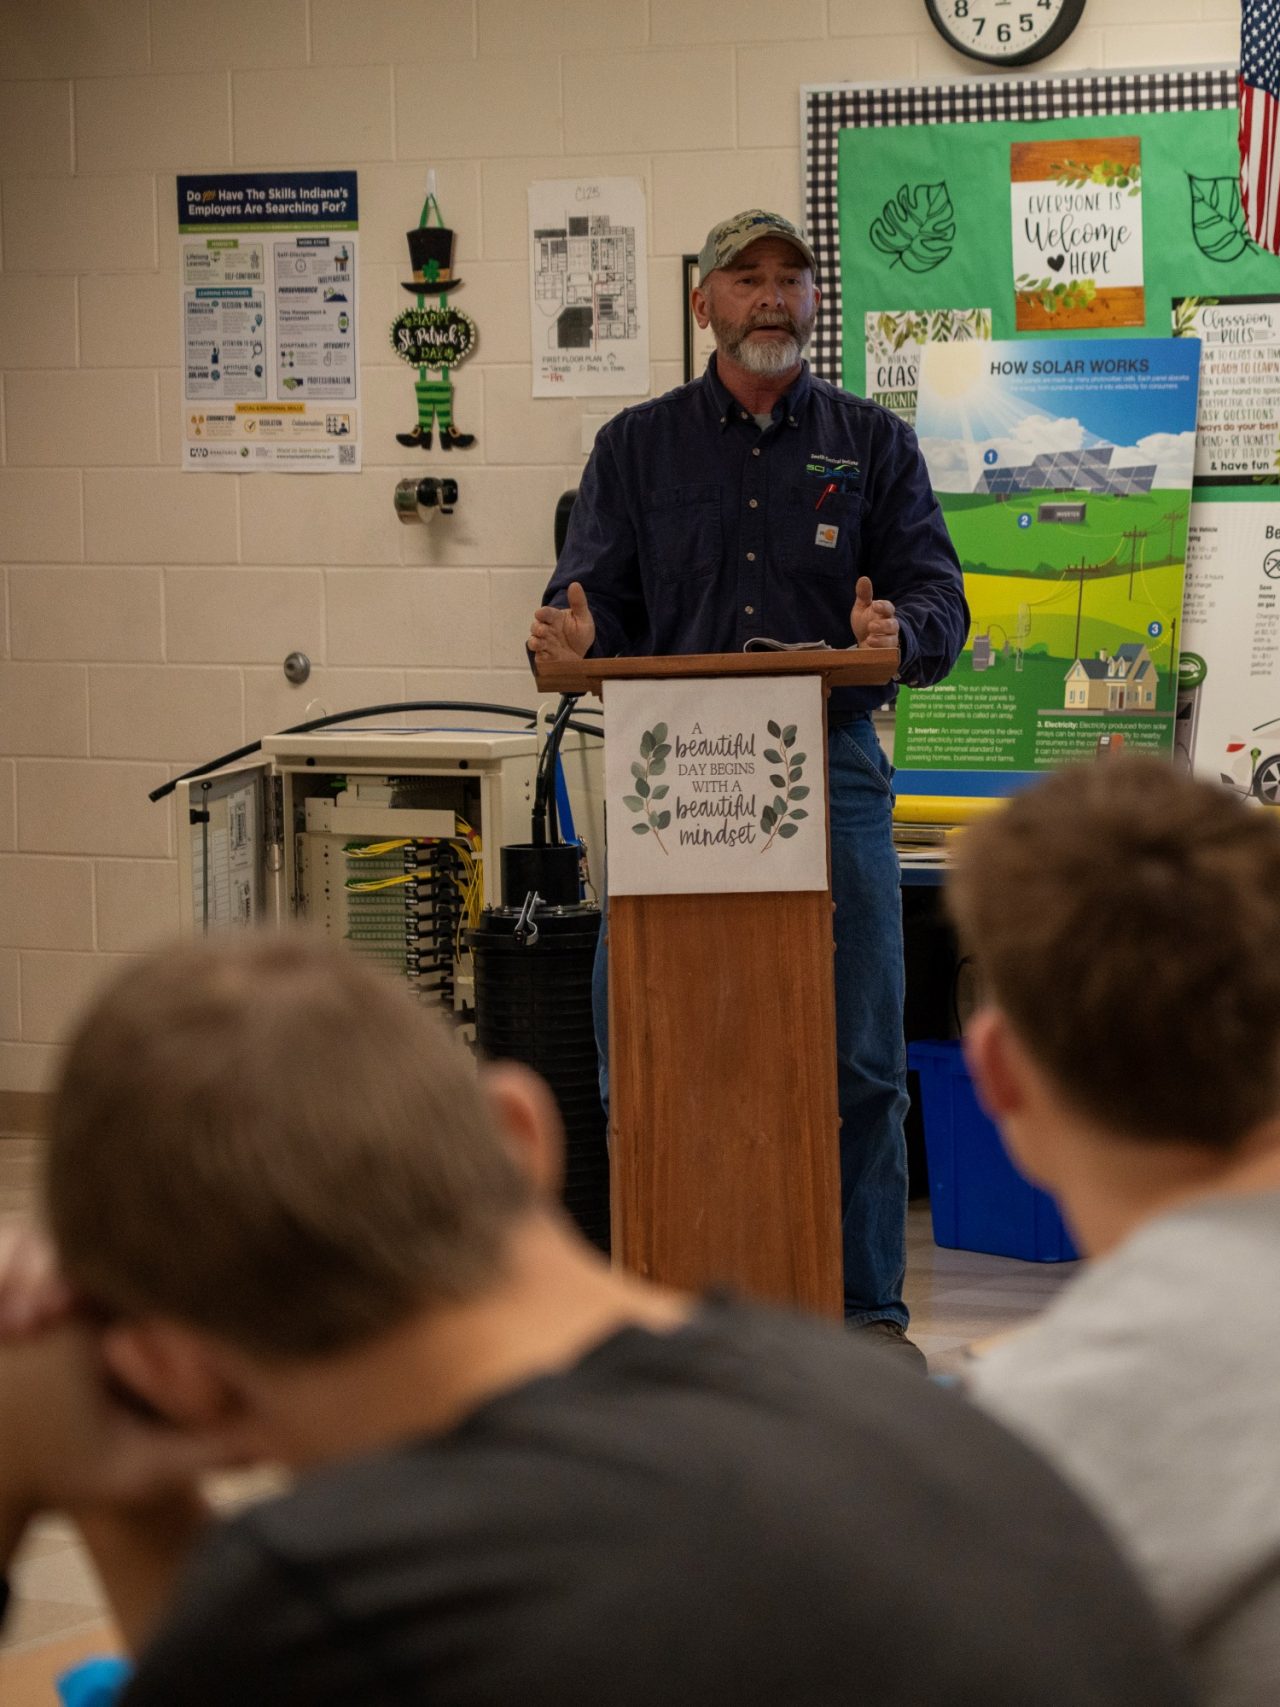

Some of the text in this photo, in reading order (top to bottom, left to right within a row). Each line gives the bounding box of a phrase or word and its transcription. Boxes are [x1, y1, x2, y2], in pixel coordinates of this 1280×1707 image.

[972, 18, 986, 36] 7
[1020, 13, 1034, 32] 5
[997, 23, 1011, 42] 6
[187, 190, 200, 202] Do
[219, 189, 244, 201] Have
[246, 188, 265, 200] The
[268, 187, 296, 199] Skills
[300, 186, 348, 199] Indiana's
[1029, 191, 1122, 214] EVERYONE IS
[188, 201, 347, 217] Employers Are Searching For?
[1025, 213, 1131, 254] Welcome
[1070, 251, 1110, 275] HERE
[413, 311, 450, 326] HAPPY
[1202, 308, 1273, 329] Classroom
[416, 326, 467, 350] Patrick's
[1221, 328, 1254, 344] RULES
[990, 358, 1150, 375] HOW SOLAR WORKS
[1223, 407, 1274, 421] QUESTIONS
[1223, 422, 1236, 432] do
[1238, 423, 1257, 433] your
[1259, 421, 1279, 430] best
[1220, 460, 1248, 471] have
[1251, 460, 1270, 470] fun
[691, 722, 703, 735] A
[676, 732, 757, 758] beautiful
[678, 762, 755, 776] DAY BEGINS
[692, 780, 742, 793] WITH A
[676, 793, 757, 819] beautiful
[679, 818, 757, 847] mindset
